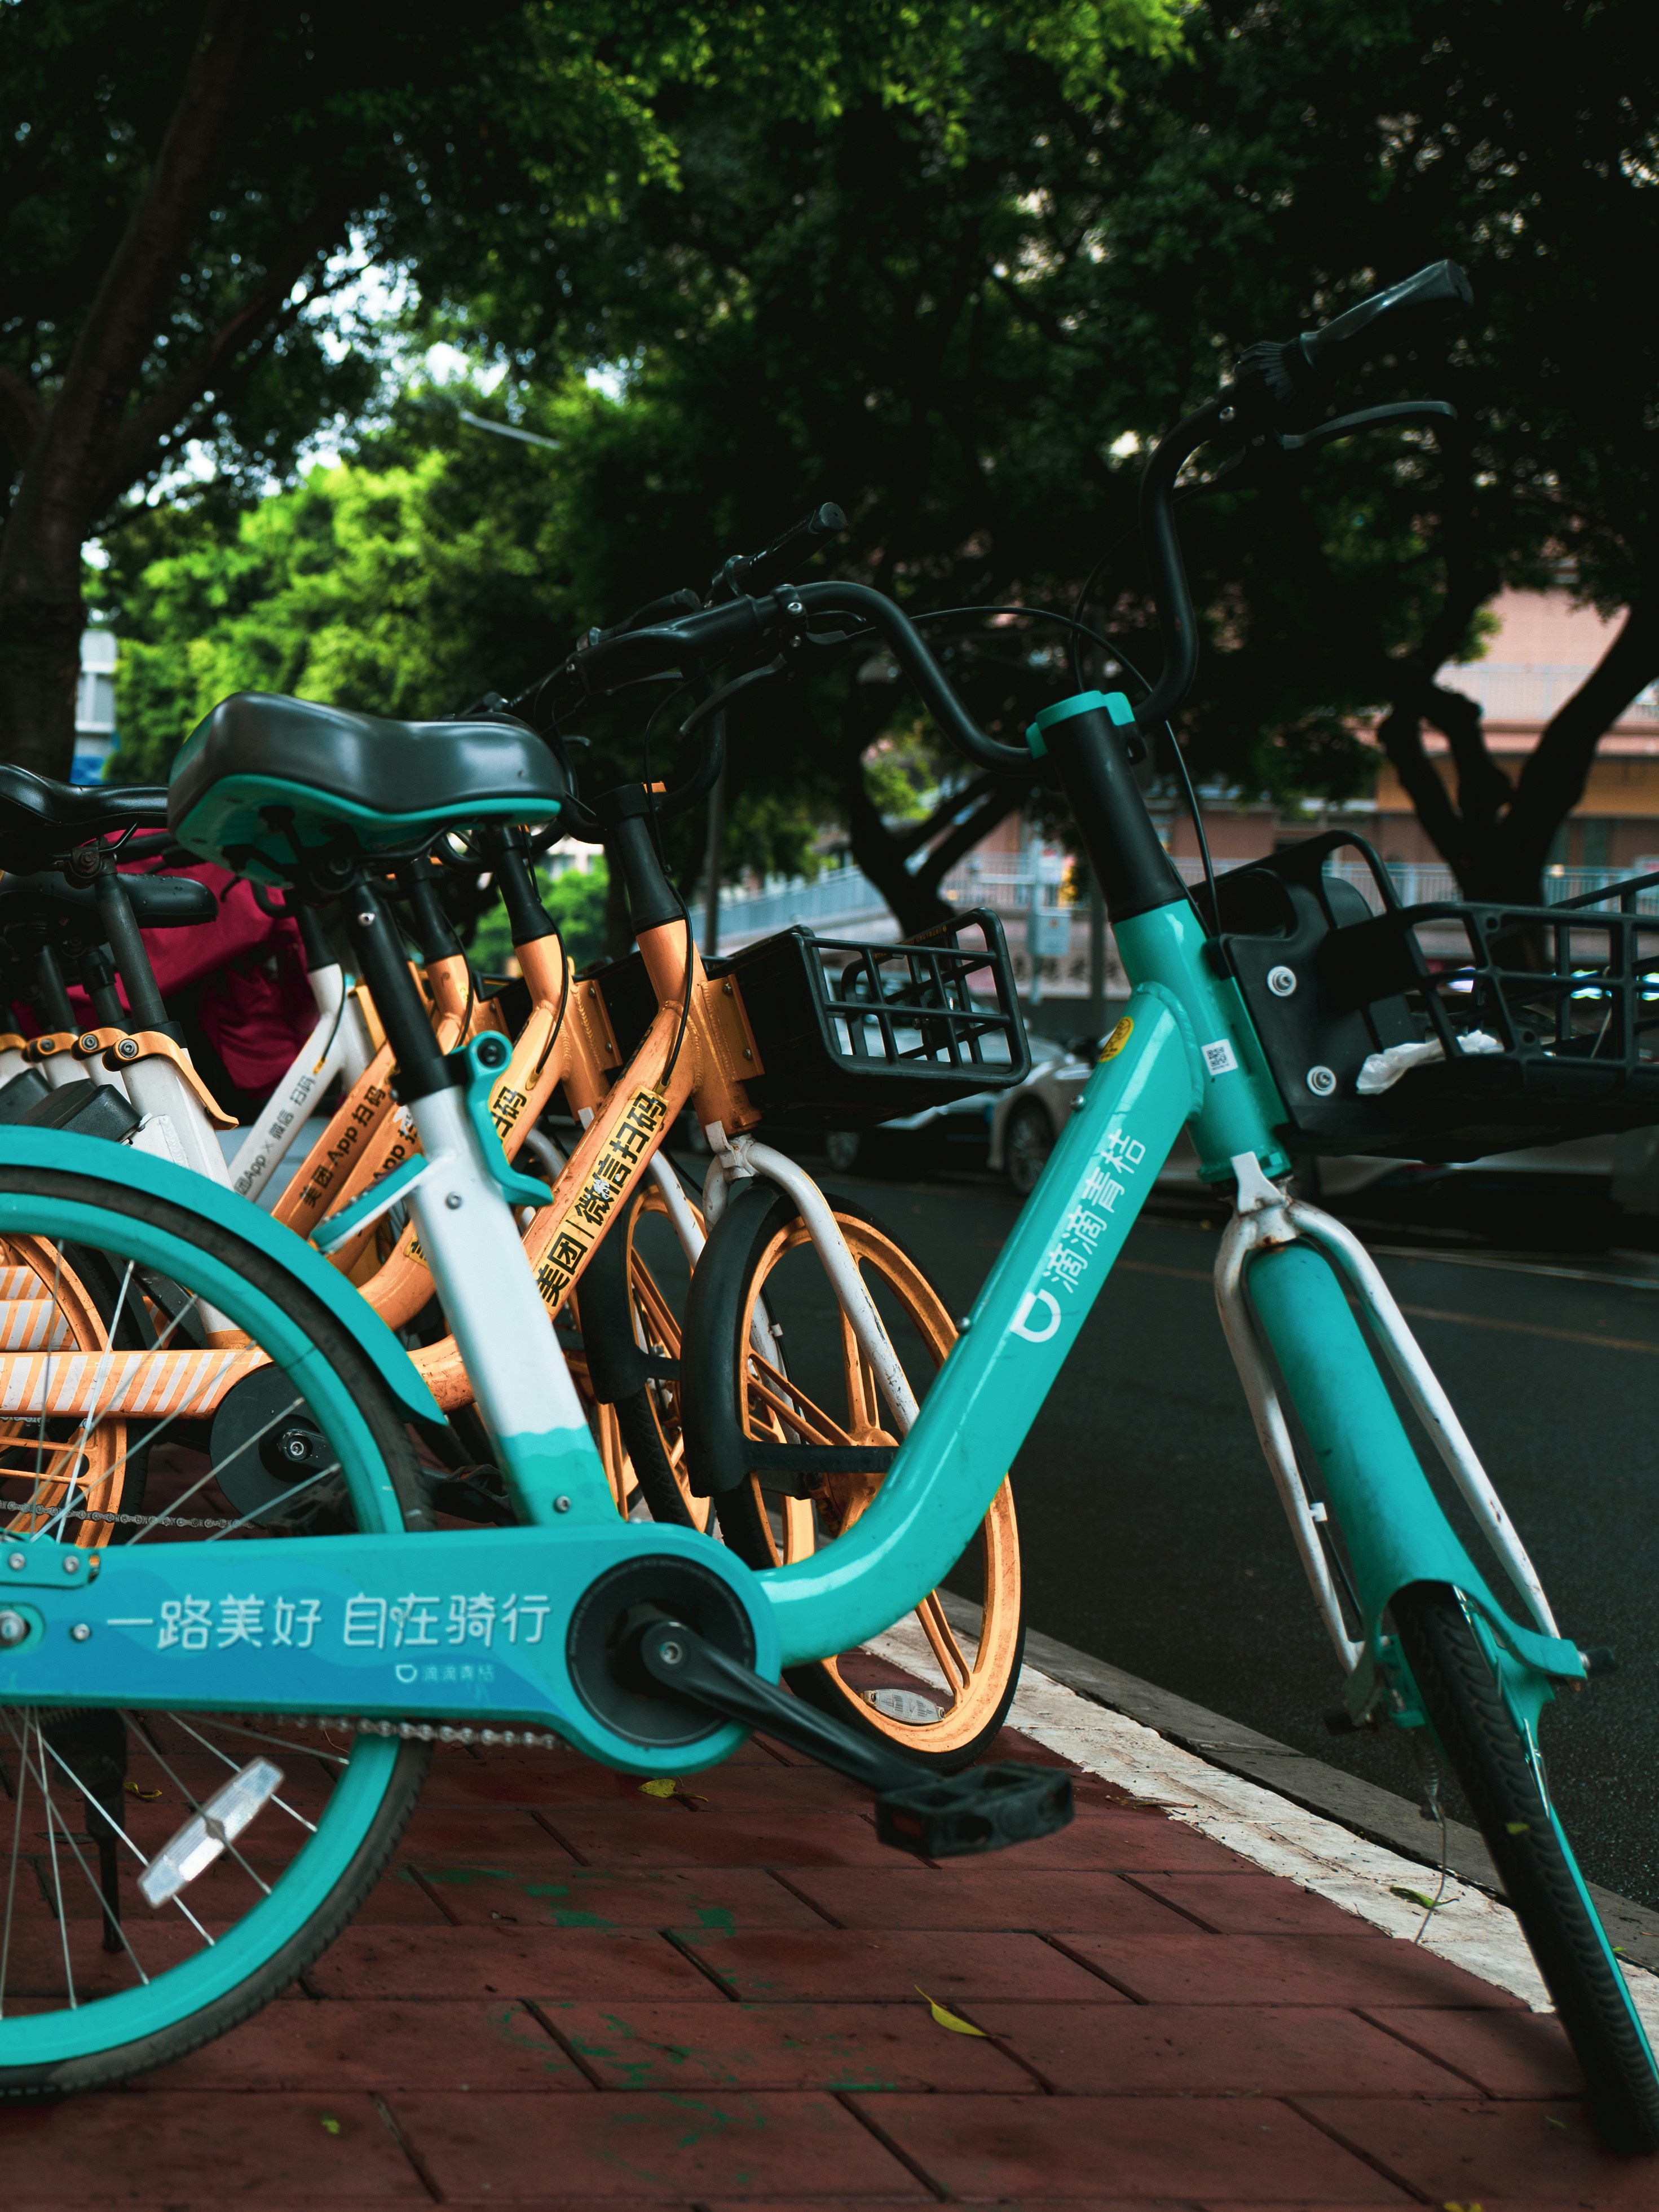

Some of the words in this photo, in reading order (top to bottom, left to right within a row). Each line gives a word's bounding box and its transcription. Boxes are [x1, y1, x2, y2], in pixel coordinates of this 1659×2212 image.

[299, 1164, 334, 1209] 美团
[326, 1125, 358, 1167] App
[351, 1085, 386, 1127] 扫码
[1042, 1128, 1146, 1293] 滴滴青桔
[107, 1593, 322, 1650] 一路美好
[343, 1592, 551, 1650] 自在骑行
